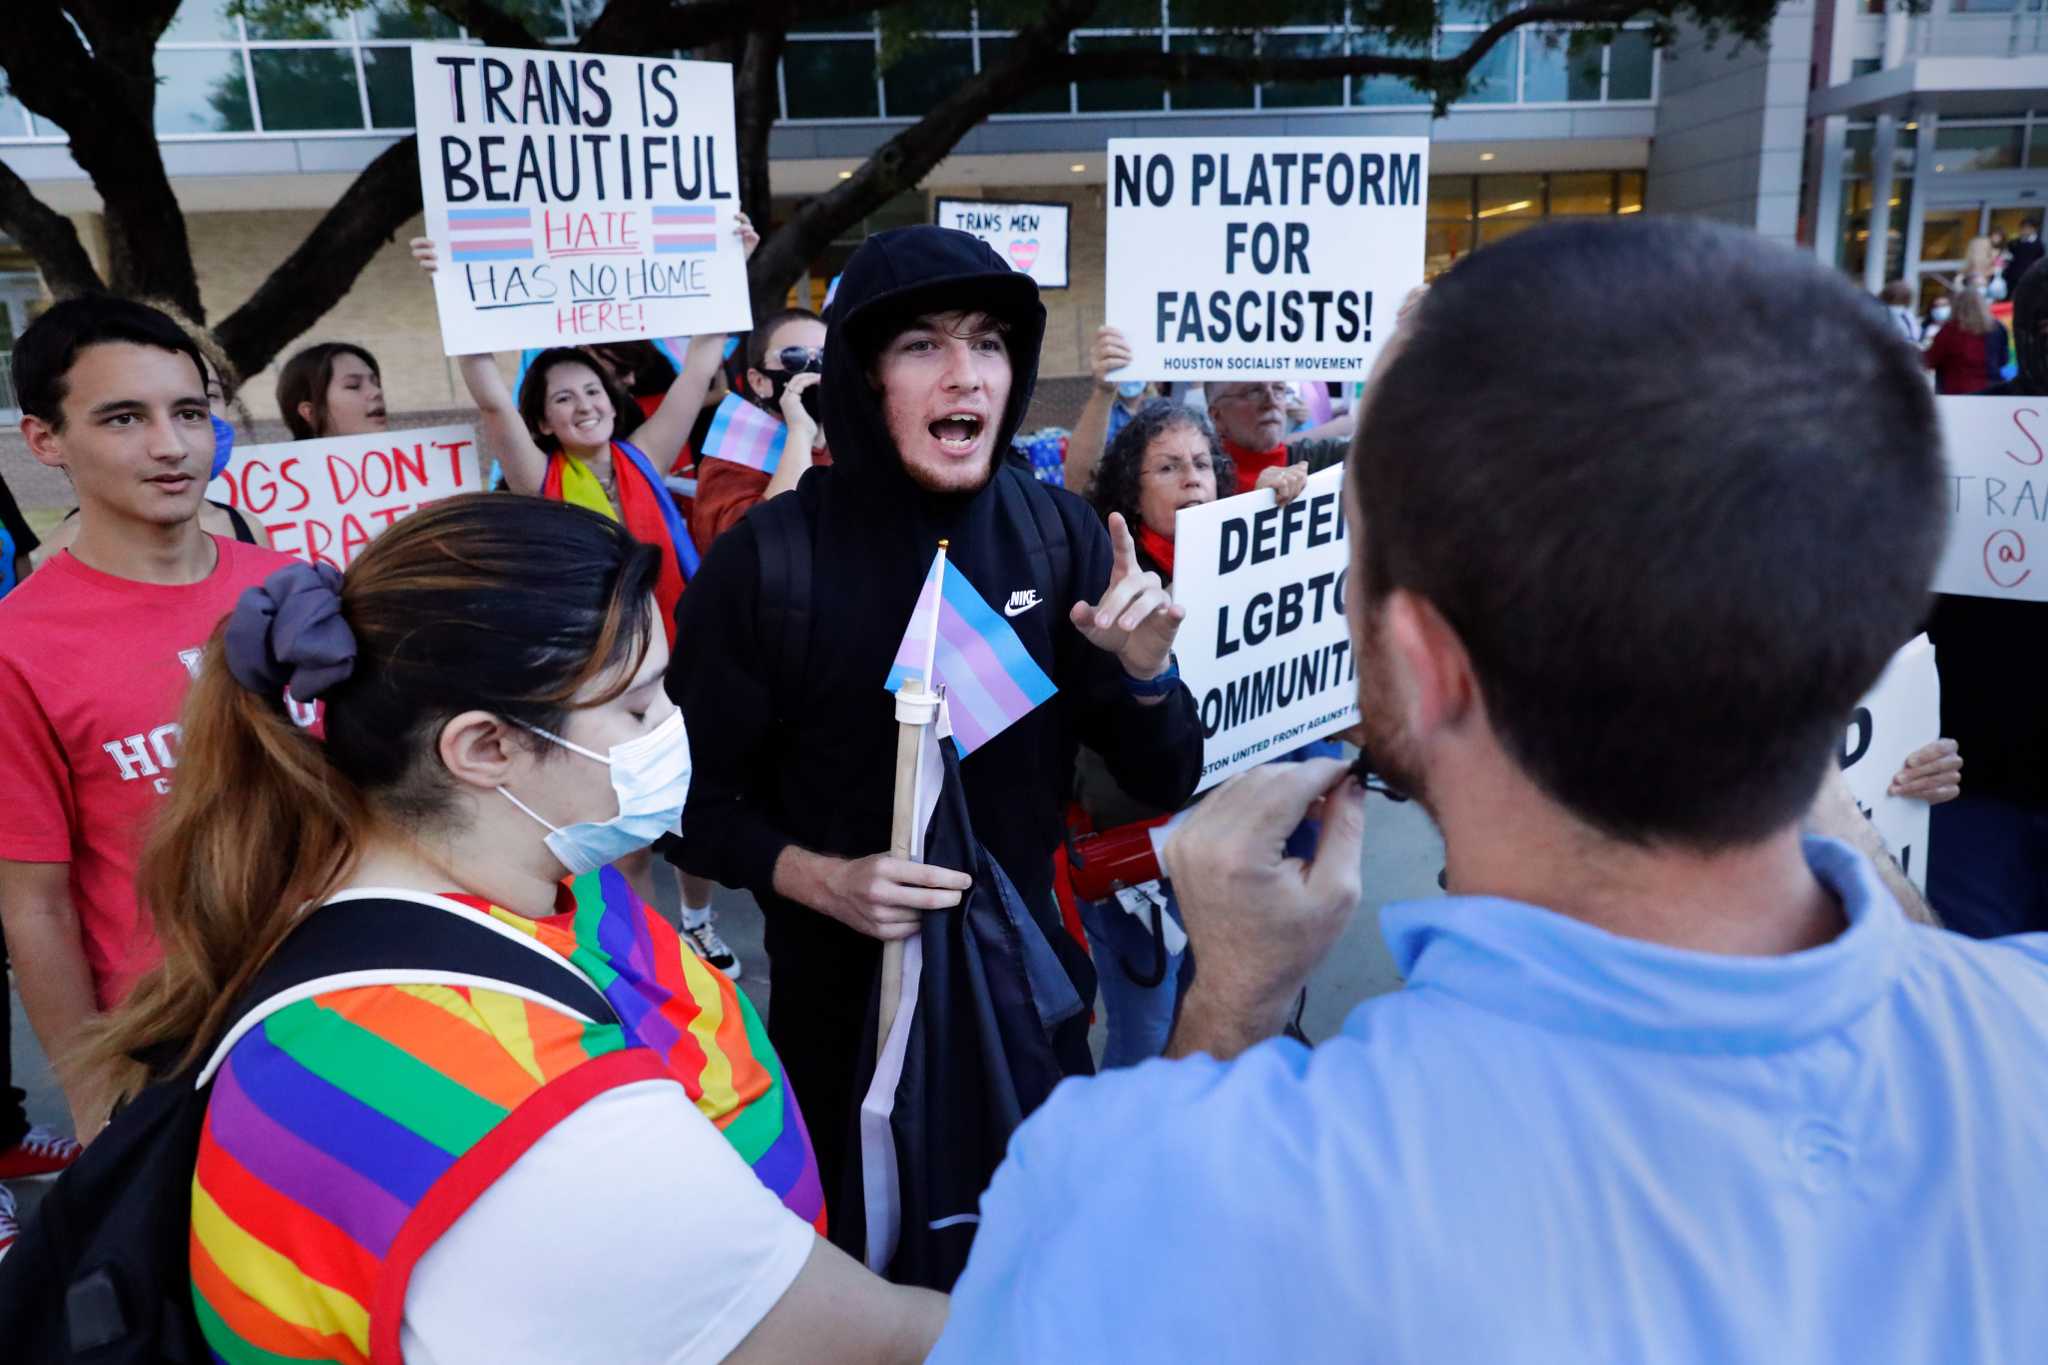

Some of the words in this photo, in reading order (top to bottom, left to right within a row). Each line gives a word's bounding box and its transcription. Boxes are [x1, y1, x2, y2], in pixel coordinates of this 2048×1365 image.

[436, 57, 612, 127] TRANS
[638, 63, 679, 127] IS
[440, 134, 732, 203] BEAUTIFUL
[1114, 154, 1174, 207] NO
[1191, 152, 1420, 206] PLATFORM
[545, 209, 640, 250] HATE
[956, 212, 1002, 232] TRANS
[1009, 214, 1040, 232] MEN
[1225, 221, 1310, 275] FOR
[466, 262, 558, 302] HAS
[570, 263, 615, 297] NO
[626, 259, 707, 296] HOME
[557, 301, 646, 334] HERE!
[1156, 289, 1373, 343] FASCISTS!
[1164, 357, 1223, 370] HOUSTON
[1227, 357, 1290, 370] SOCIALIST
[1295, 357, 1363, 370] MOVEMENT
[326, 440, 472, 505] DON'T
[1984, 529, 2031, 588] @
[1010, 589, 1036, 606] NIKE
[1232, 738, 1271, 763] UNITED
[1272, 723, 1306, 744] FRONT
[1307, 706, 1349, 730] AGAINST
